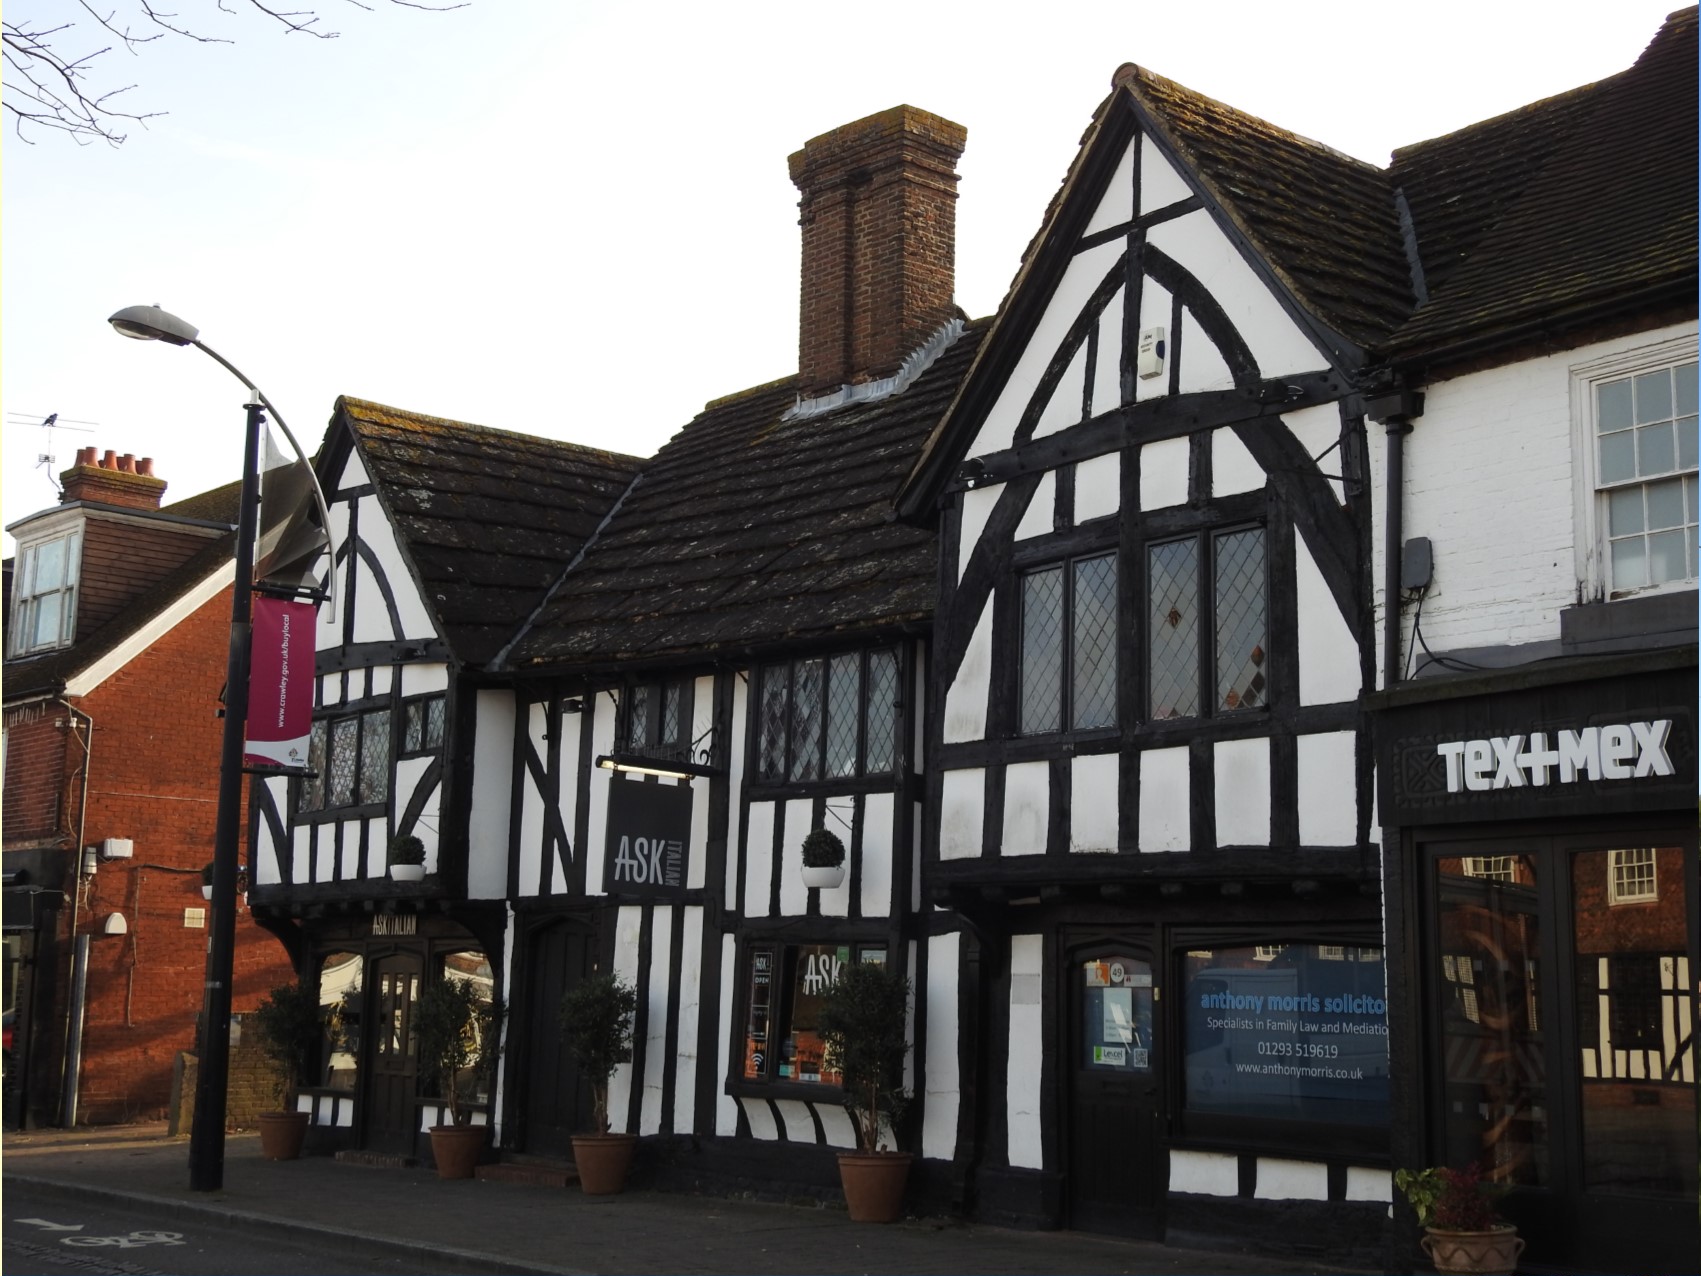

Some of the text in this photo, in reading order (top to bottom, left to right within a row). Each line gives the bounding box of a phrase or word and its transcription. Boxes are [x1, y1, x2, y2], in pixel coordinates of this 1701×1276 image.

[278, 614, 290, 728] www.crawley.gov.uk/buylocal
[615, 835, 665, 885] ASK
[664, 840, 682, 887] ITALIAN
[1201, 990, 1265, 1014] anthony
[1268, 993, 1320, 1012] morris
[1207, 1016, 1253, 1031] Specialists
[1255, 1018, 1264, 1030] in
[1266, 1018, 1298, 1034] Family
[1299, 1020, 1318, 1033] Law
[1321, 1021, 1340, 1033] and
[1258, 1041, 1338, 1059] 01293 519619
[1236, 1062, 1363, 1080] www.anthonymorris.co.uk
